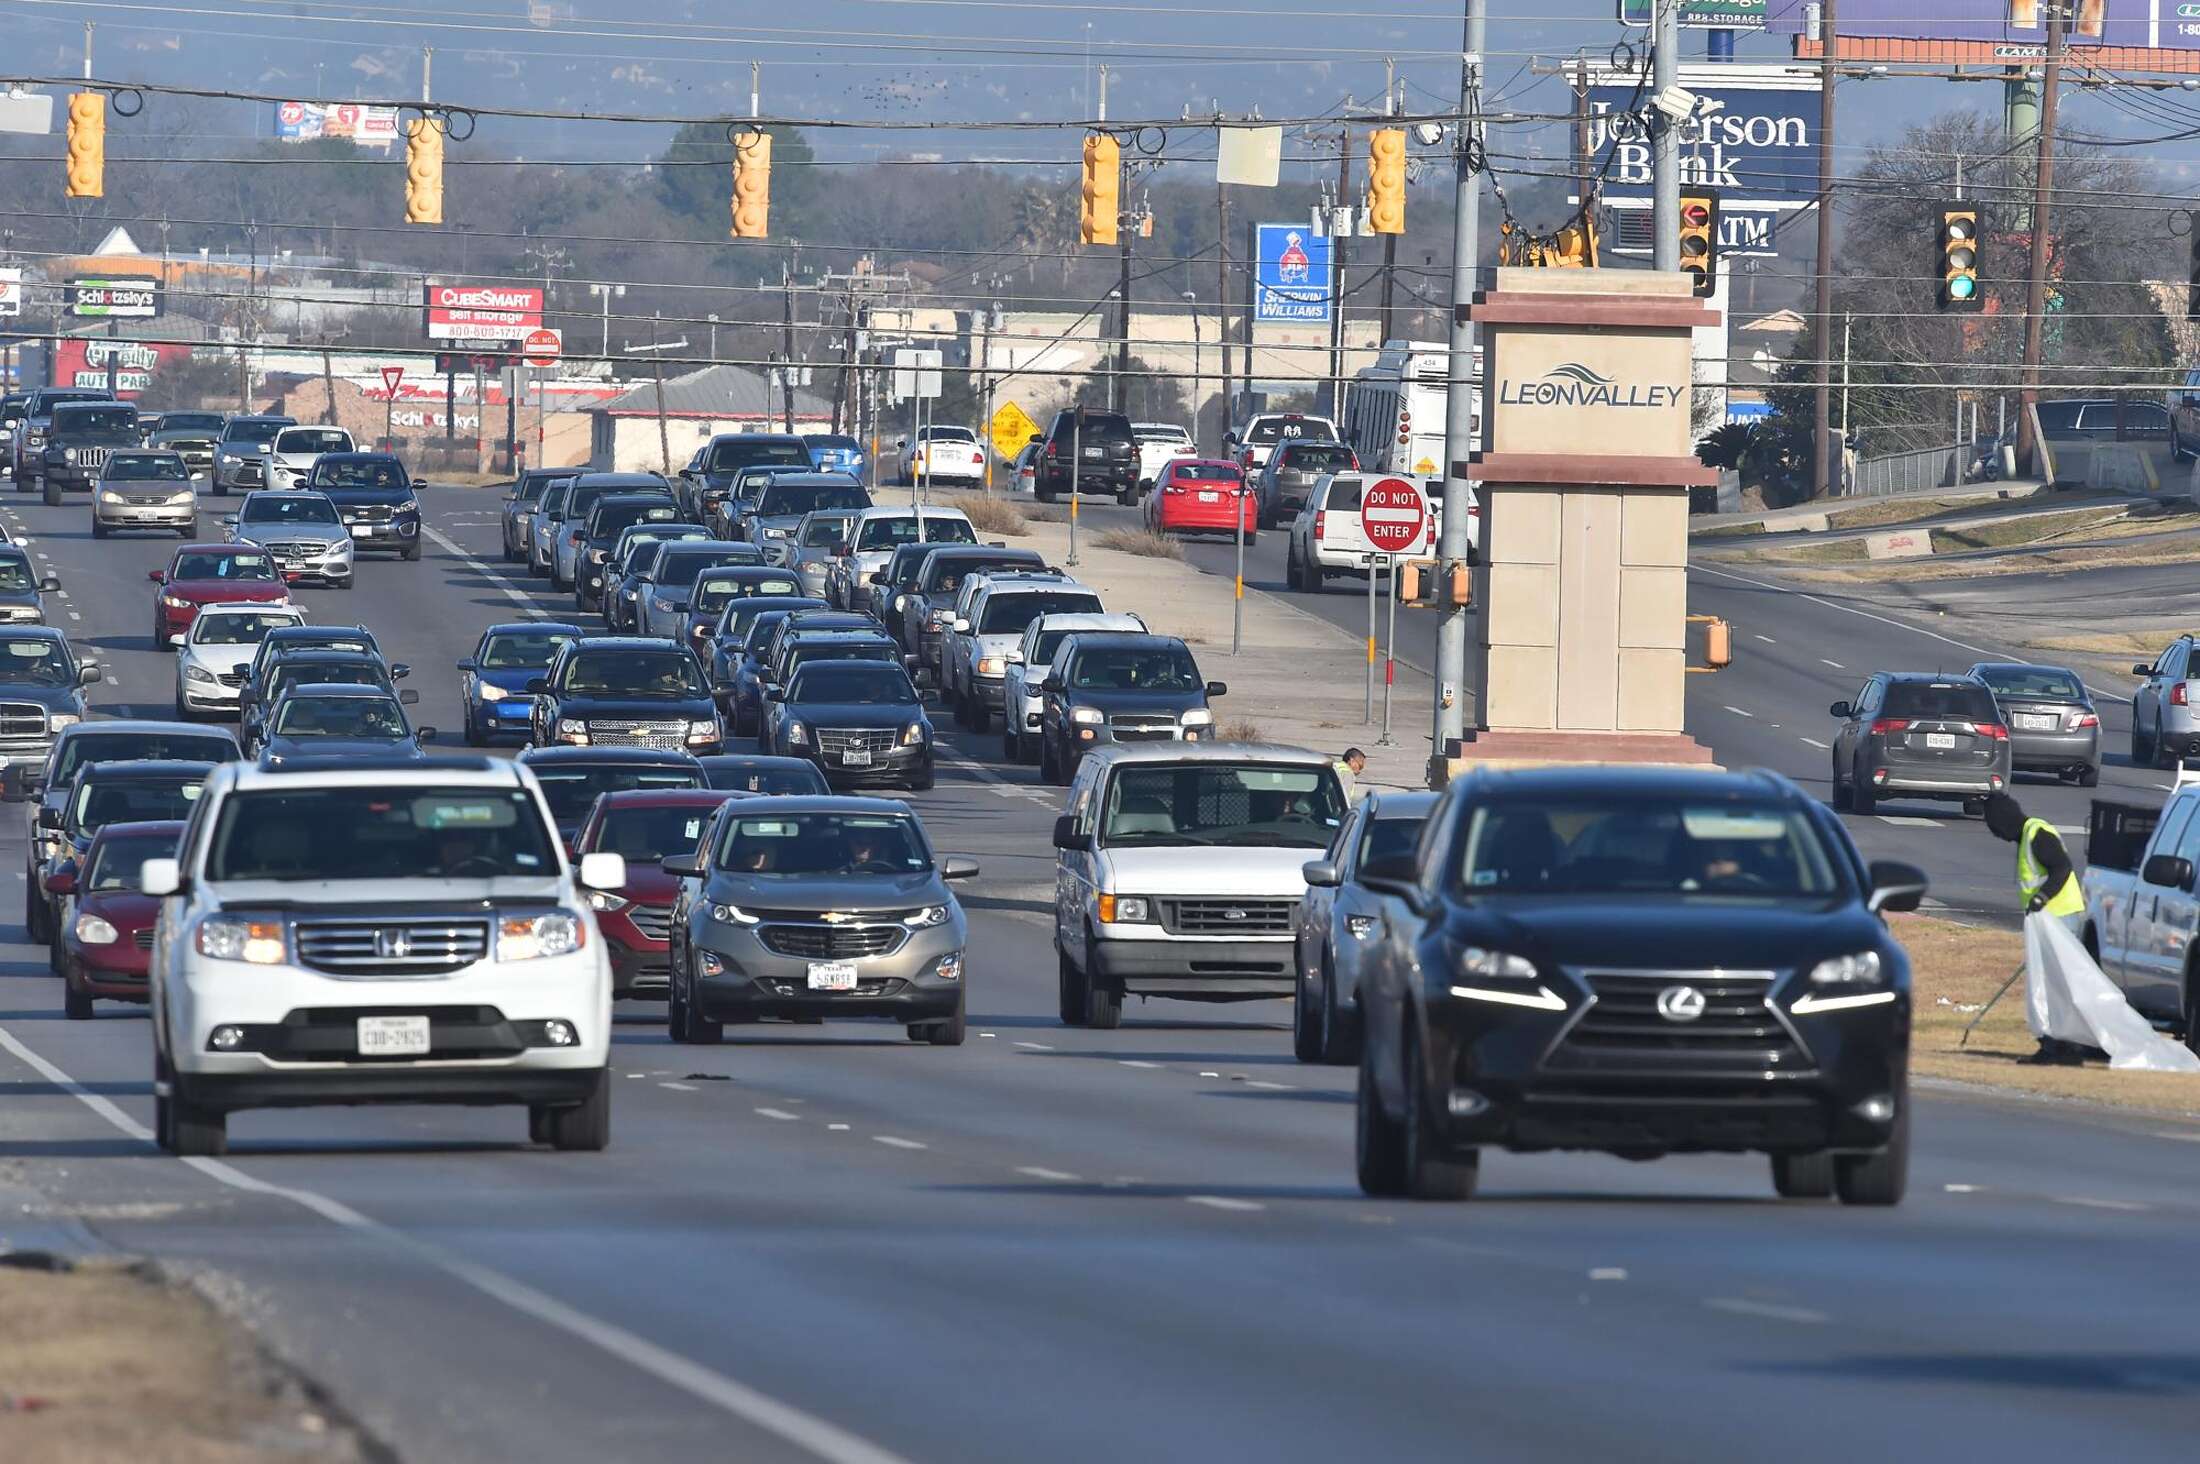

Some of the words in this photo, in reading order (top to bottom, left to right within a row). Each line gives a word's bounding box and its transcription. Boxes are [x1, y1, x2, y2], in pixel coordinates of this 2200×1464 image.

[1617, 144, 1742, 186] Bnk
[78, 289, 154, 307] Schlotzsky's
[1263, 304, 1323, 316] WILLIAMS
[78, 375, 106, 387] AUT
[390, 411, 479, 428] Schlotzky's
[1371, 491, 1386, 504] DO
[1392, 492, 1416, 505] NOT
[1373, 525, 1409, 538] ENTER
